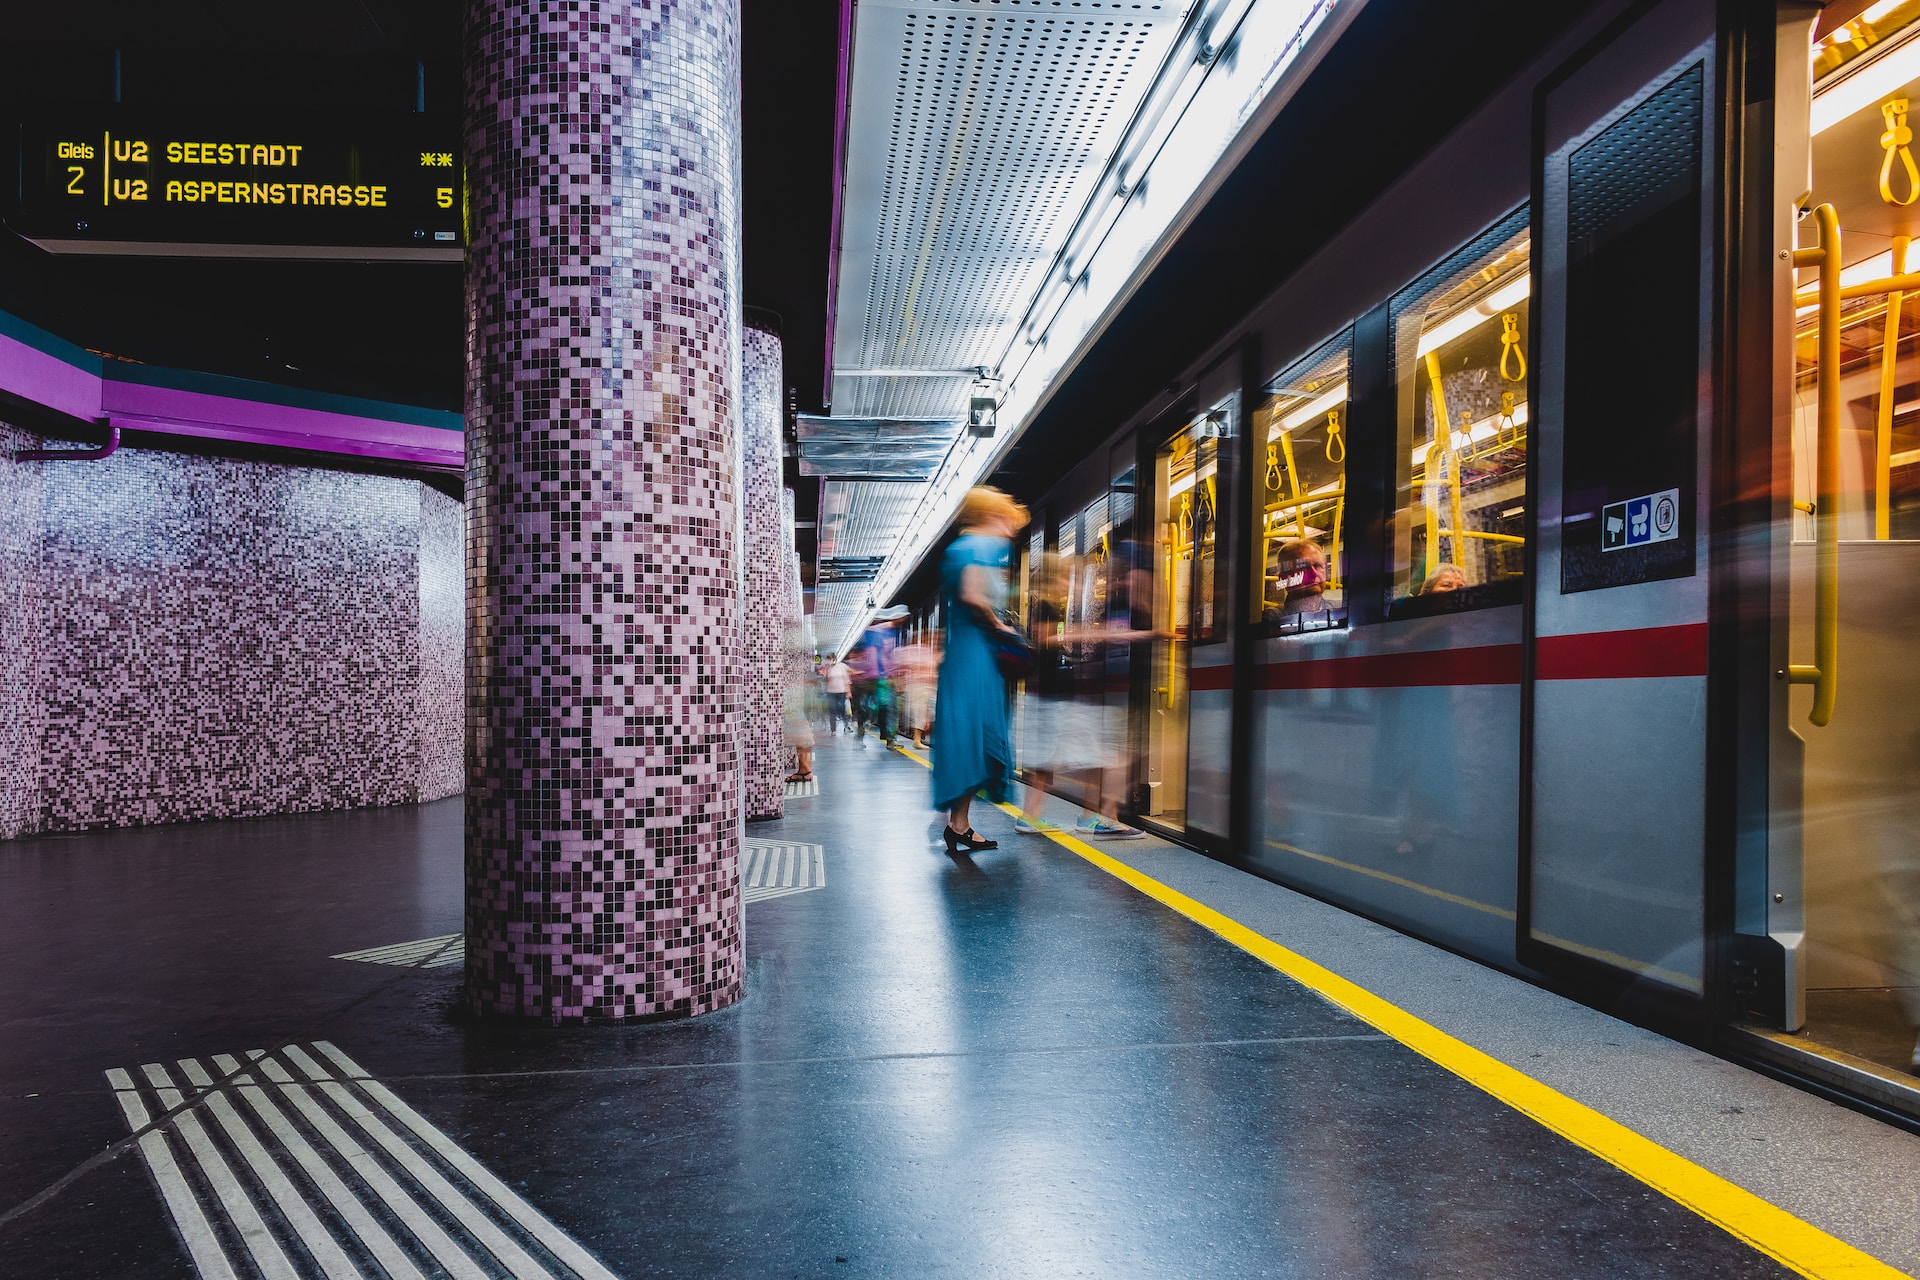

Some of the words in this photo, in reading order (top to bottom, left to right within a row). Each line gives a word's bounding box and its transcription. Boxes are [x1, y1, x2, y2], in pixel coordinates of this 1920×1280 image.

[58, 142, 95, 160] Gleis
[113, 140, 149, 162] U2
[166, 141, 302, 167] SEESTADT
[67, 166, 84, 195] 2
[113, 178, 148, 201] U2
[166, 180, 387, 207] ASPERNSTRASSE
[437, 187, 453, 209] 5
